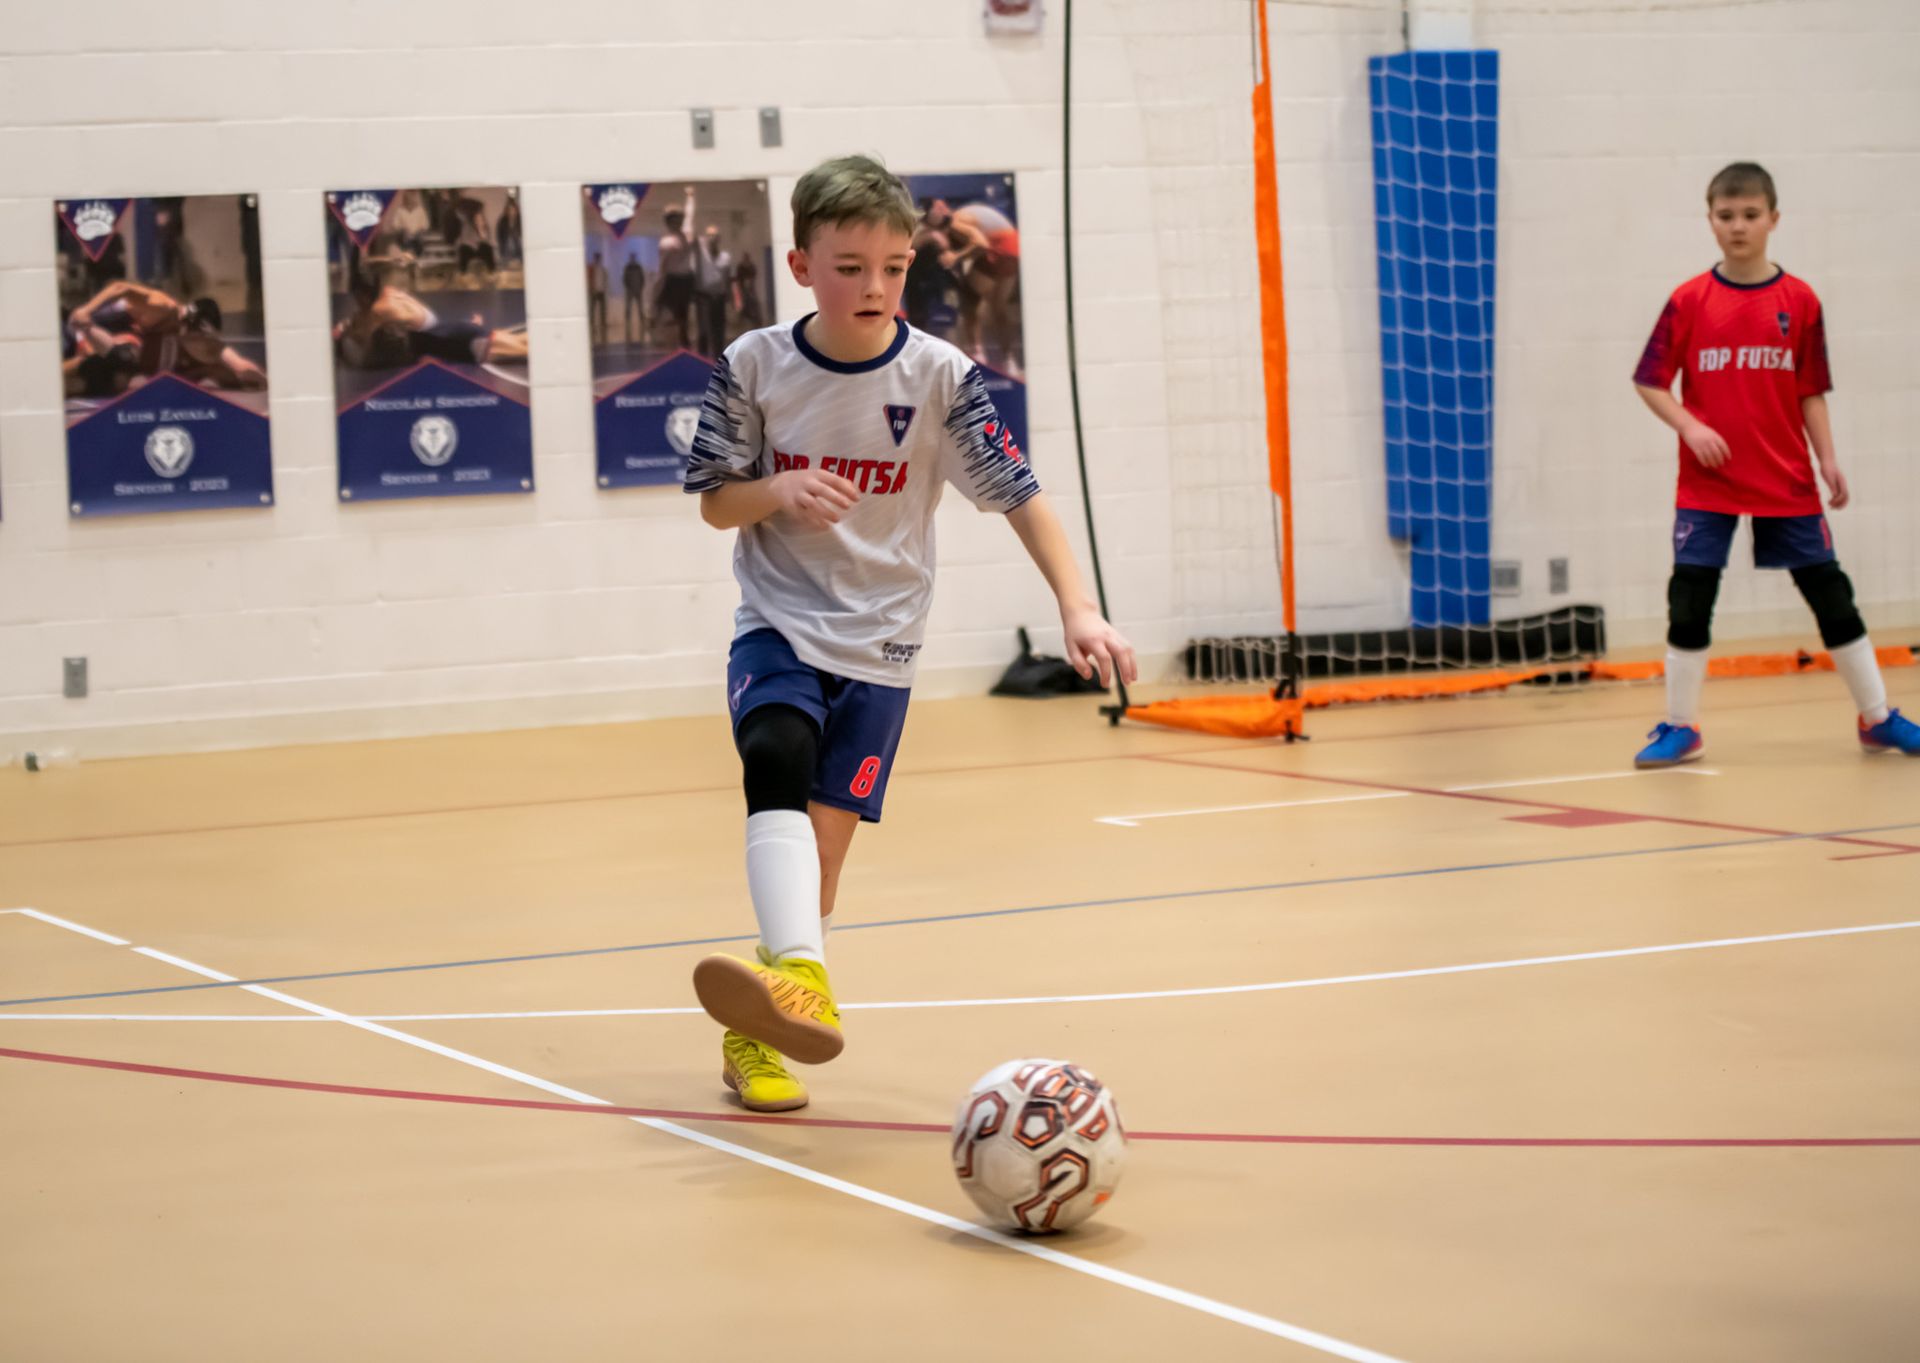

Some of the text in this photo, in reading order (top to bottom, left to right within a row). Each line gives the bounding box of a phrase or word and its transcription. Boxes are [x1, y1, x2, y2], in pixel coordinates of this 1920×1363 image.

[1699, 347, 1732, 372] FDP
[850, 755, 881, 798] 8
[757, 969, 831, 1022] NIKE
